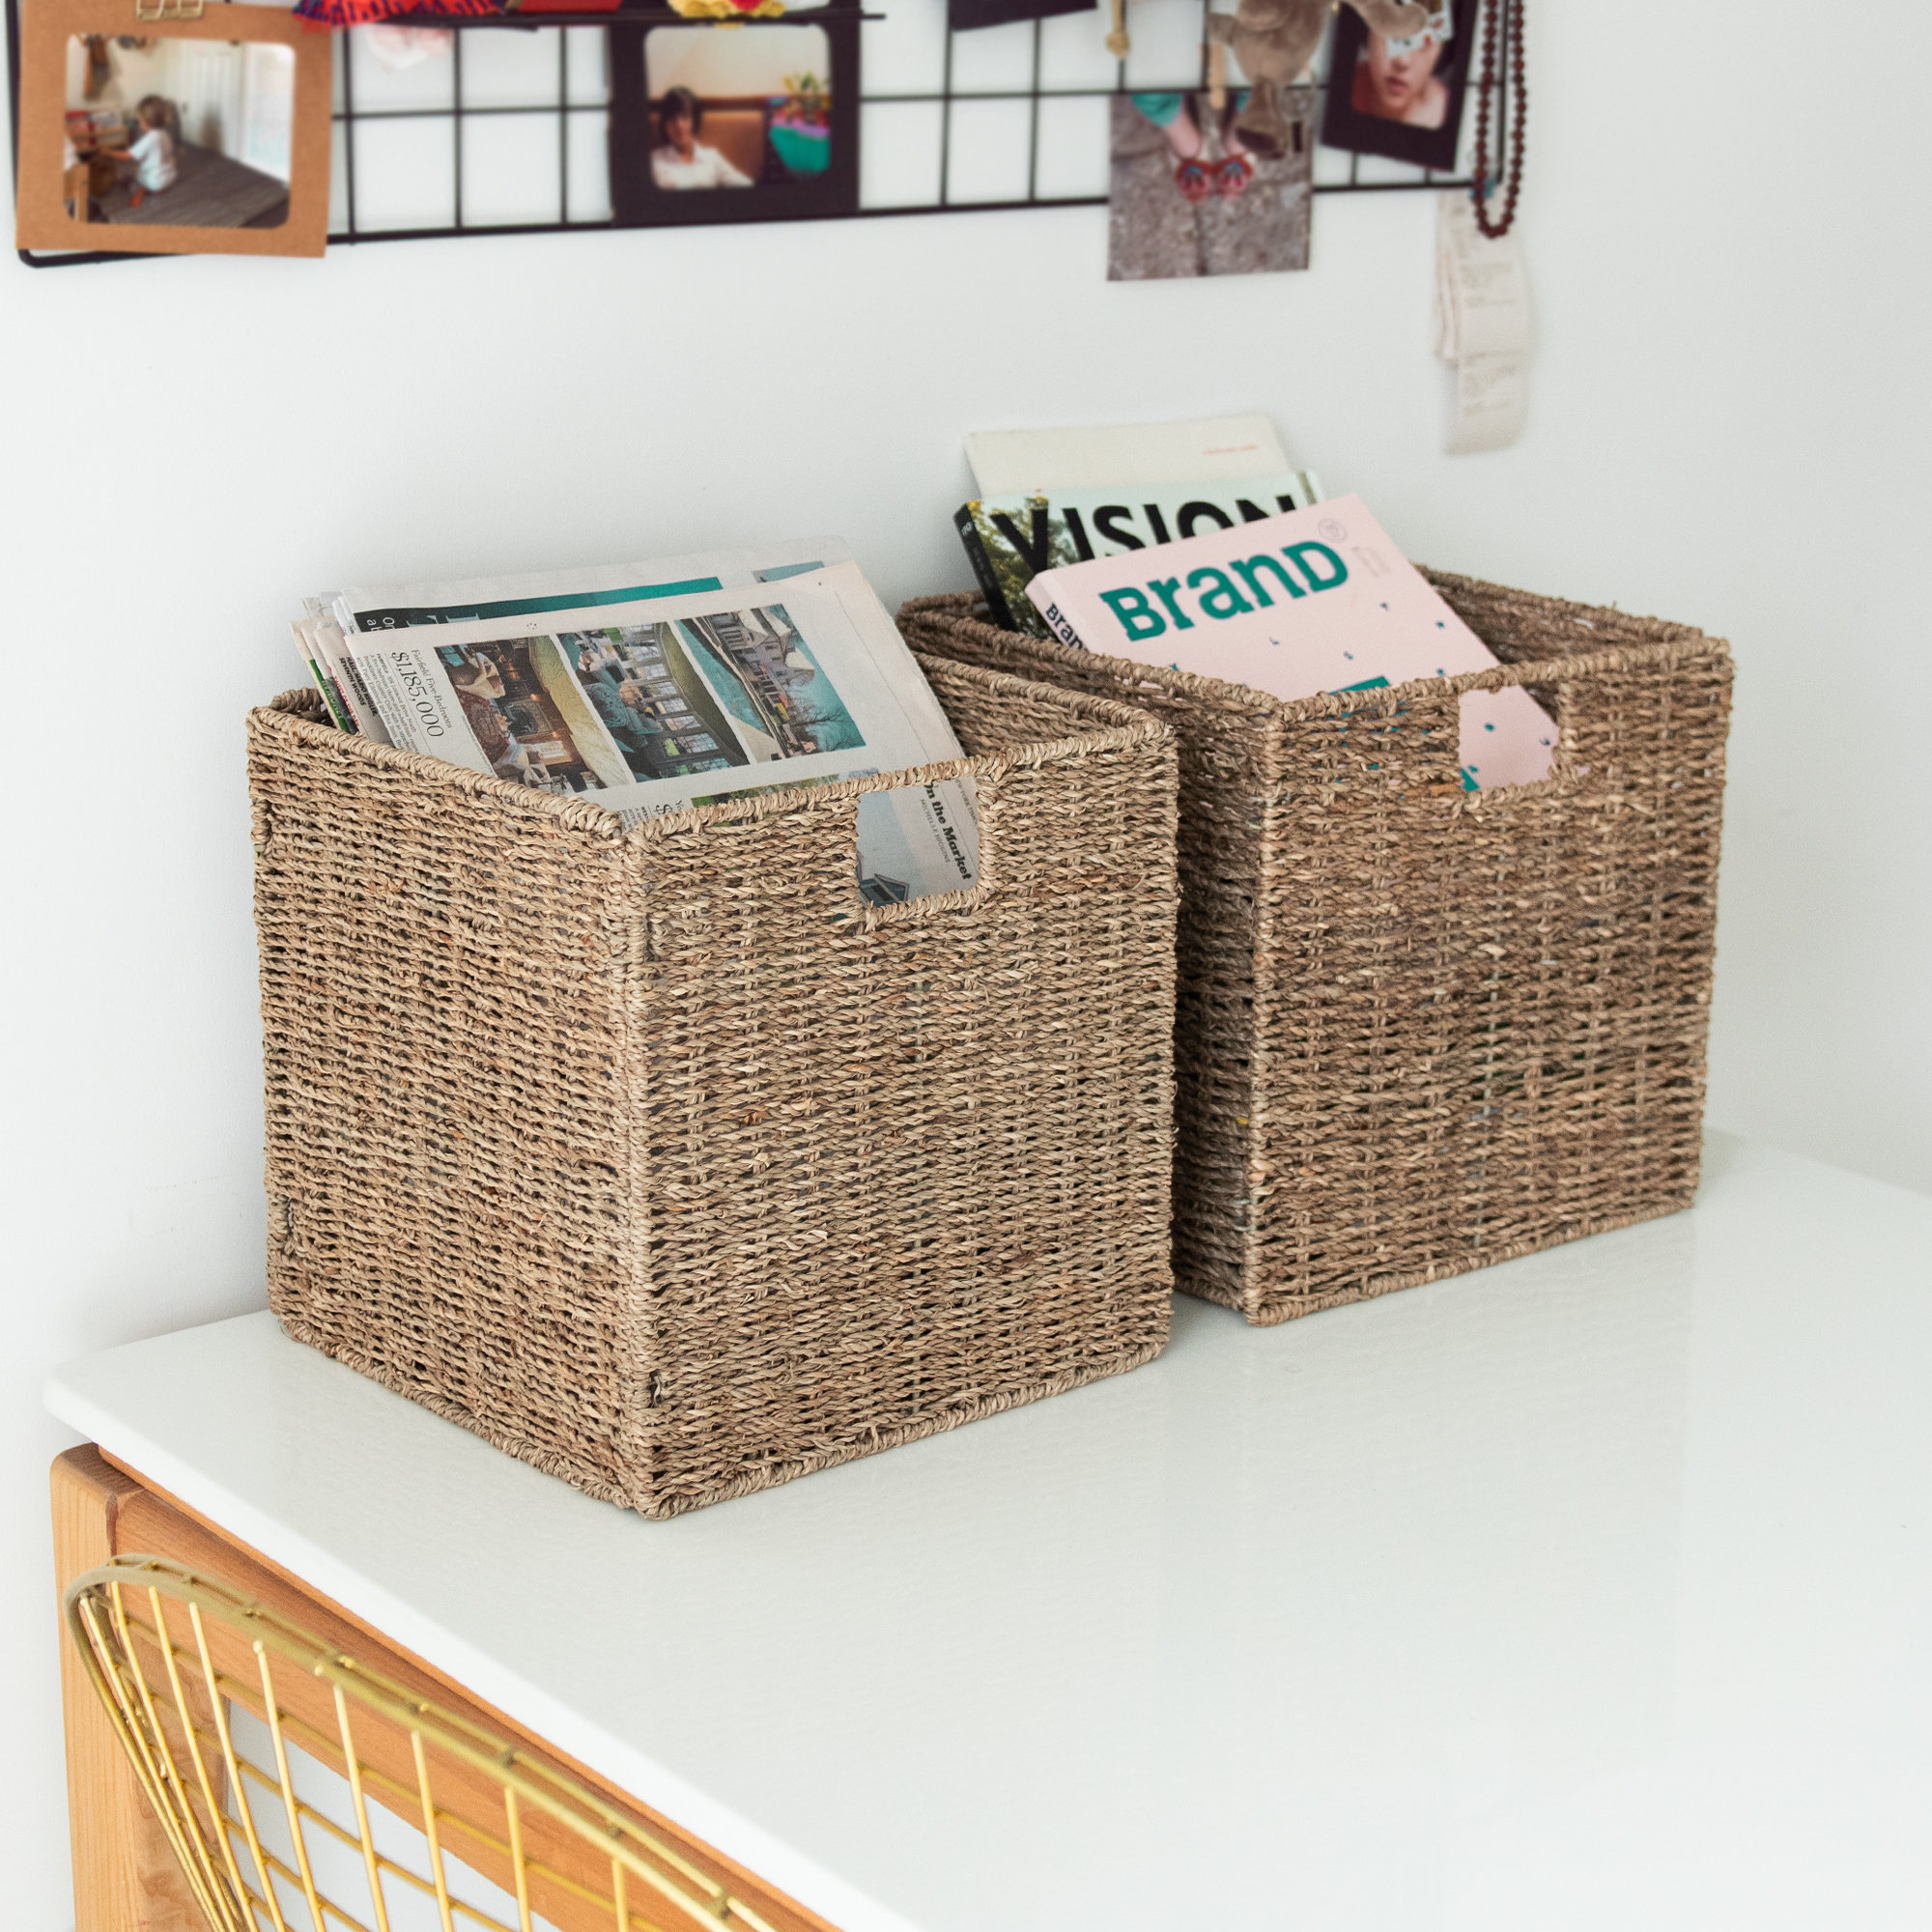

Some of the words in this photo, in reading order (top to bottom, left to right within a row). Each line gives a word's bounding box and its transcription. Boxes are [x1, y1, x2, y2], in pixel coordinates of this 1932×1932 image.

[352, 683, 366, 705] WOODS
[391, 651, 444, 737] $1,185,000
[426, 677, 452, 728] Five-Bedroom
[931, 801, 946, 823] the
[943, 826, 972, 880] Market
